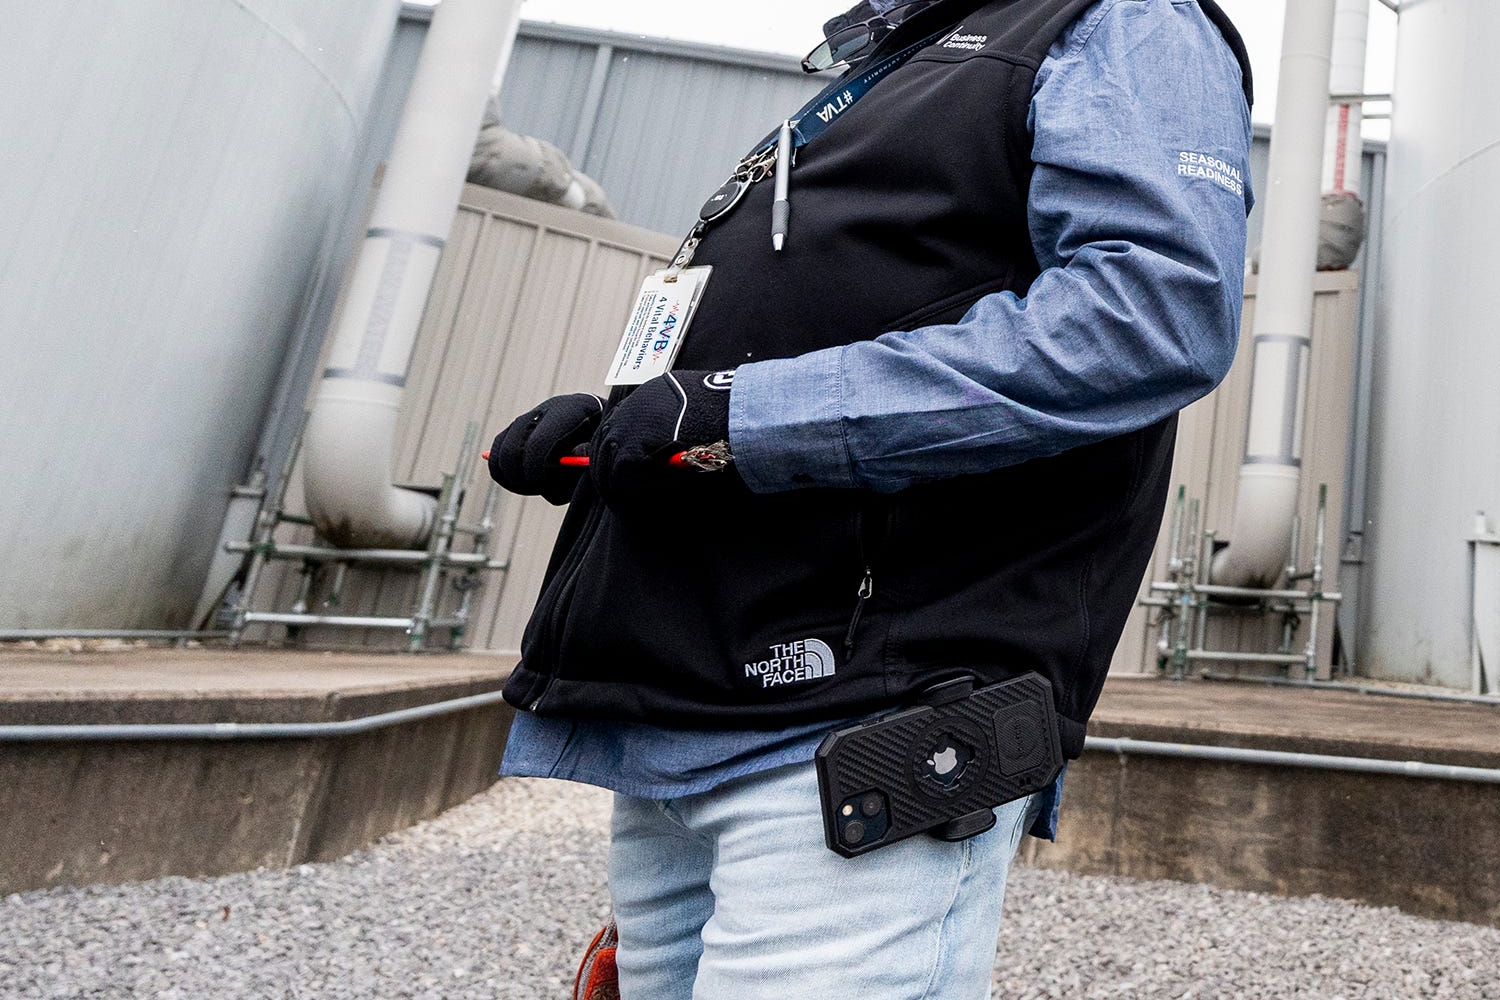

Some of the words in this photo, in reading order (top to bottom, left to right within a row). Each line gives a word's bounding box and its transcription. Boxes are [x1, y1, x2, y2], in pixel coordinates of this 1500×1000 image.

[943, 41, 985, 51] Continuity
[950, 33, 987, 43] Business
[816, 90, 853, 123] #TVA
[1179, 152, 1242, 183] SEASONAL
[1177, 164, 1242, 195] READINESS
[650, 303, 665, 325] Vital
[654, 314, 677, 351] 4VB
[633, 326, 657, 370] Behaviors
[769, 640, 804, 658] THE
[745, 654, 804, 677] NORTH
[763, 667, 805, 688] FACE
